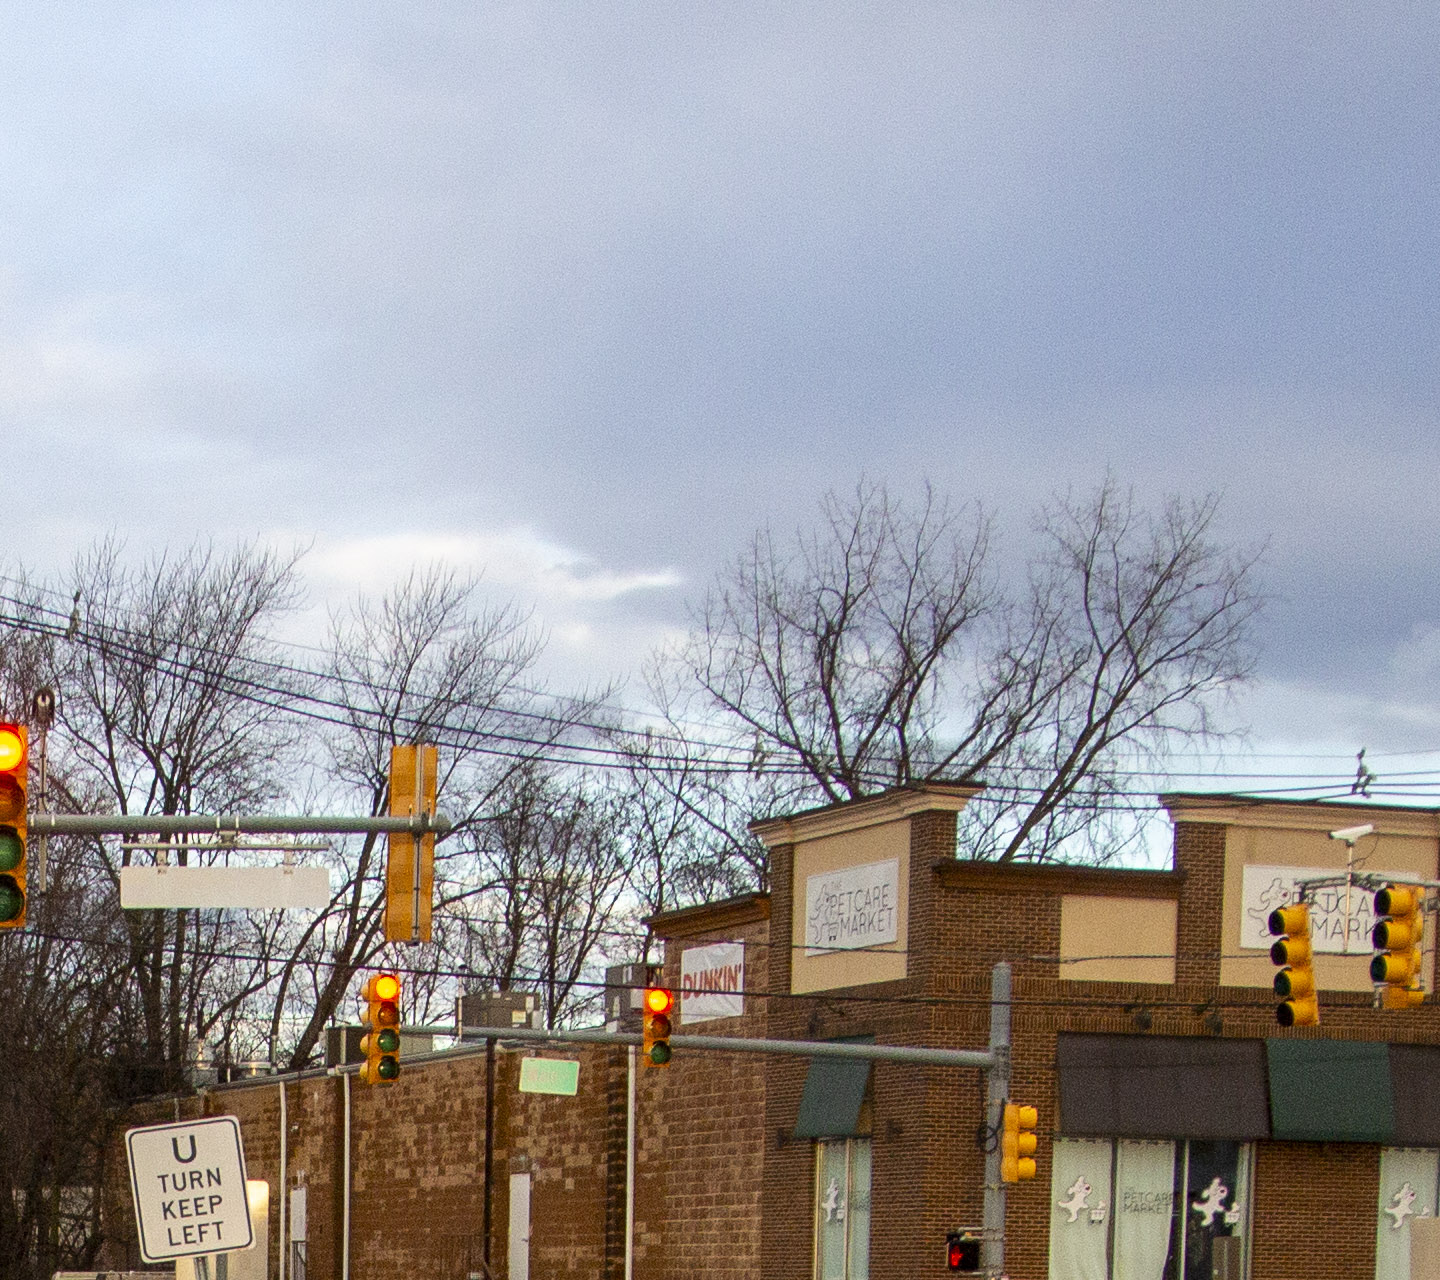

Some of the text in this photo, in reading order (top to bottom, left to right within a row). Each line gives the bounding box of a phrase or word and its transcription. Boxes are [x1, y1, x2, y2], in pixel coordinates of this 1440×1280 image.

[828, 883, 890, 918] PETCARE
[839, 907, 894, 939] MARKET
[682, 963, 742, 1000] DUNKIN'
[172, 1135, 197, 1164] U
[157, 1167, 222, 1193] TURN
[162, 1195, 223, 1221] KEEP
[167, 1221, 224, 1246] LEFT
